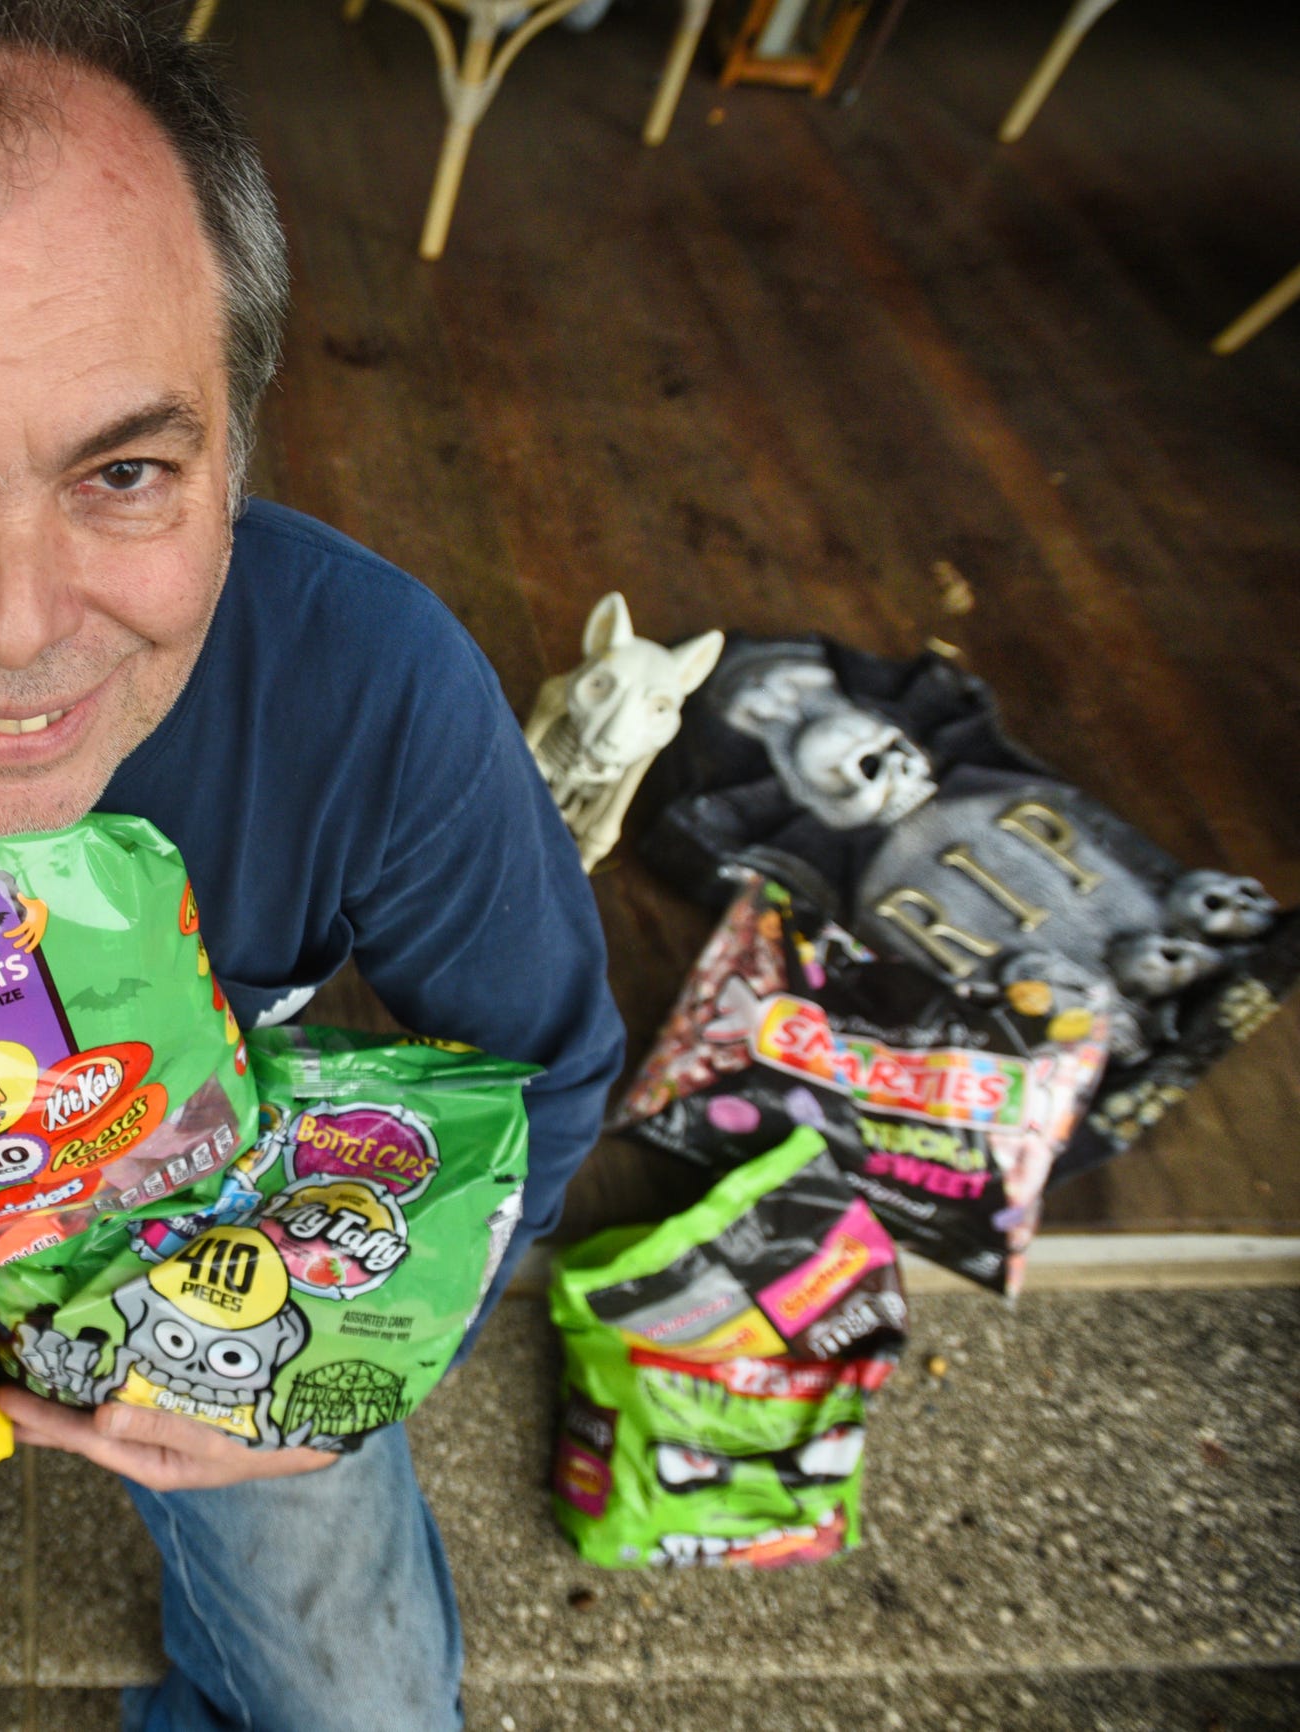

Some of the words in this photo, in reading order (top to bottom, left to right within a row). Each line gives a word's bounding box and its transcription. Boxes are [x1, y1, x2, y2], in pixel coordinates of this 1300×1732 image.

[875, 803, 1105, 978] RIP
[51, 1096, 149, 1173] Reese's
[296, 1114, 378, 1167] BOTTLE
[373, 1145, 436, 1178] CAPS
[175, 1237, 260, 1296] 410
[326, 1209, 409, 1272] Taffy
[180, 1281, 244, 1313] PIECES
